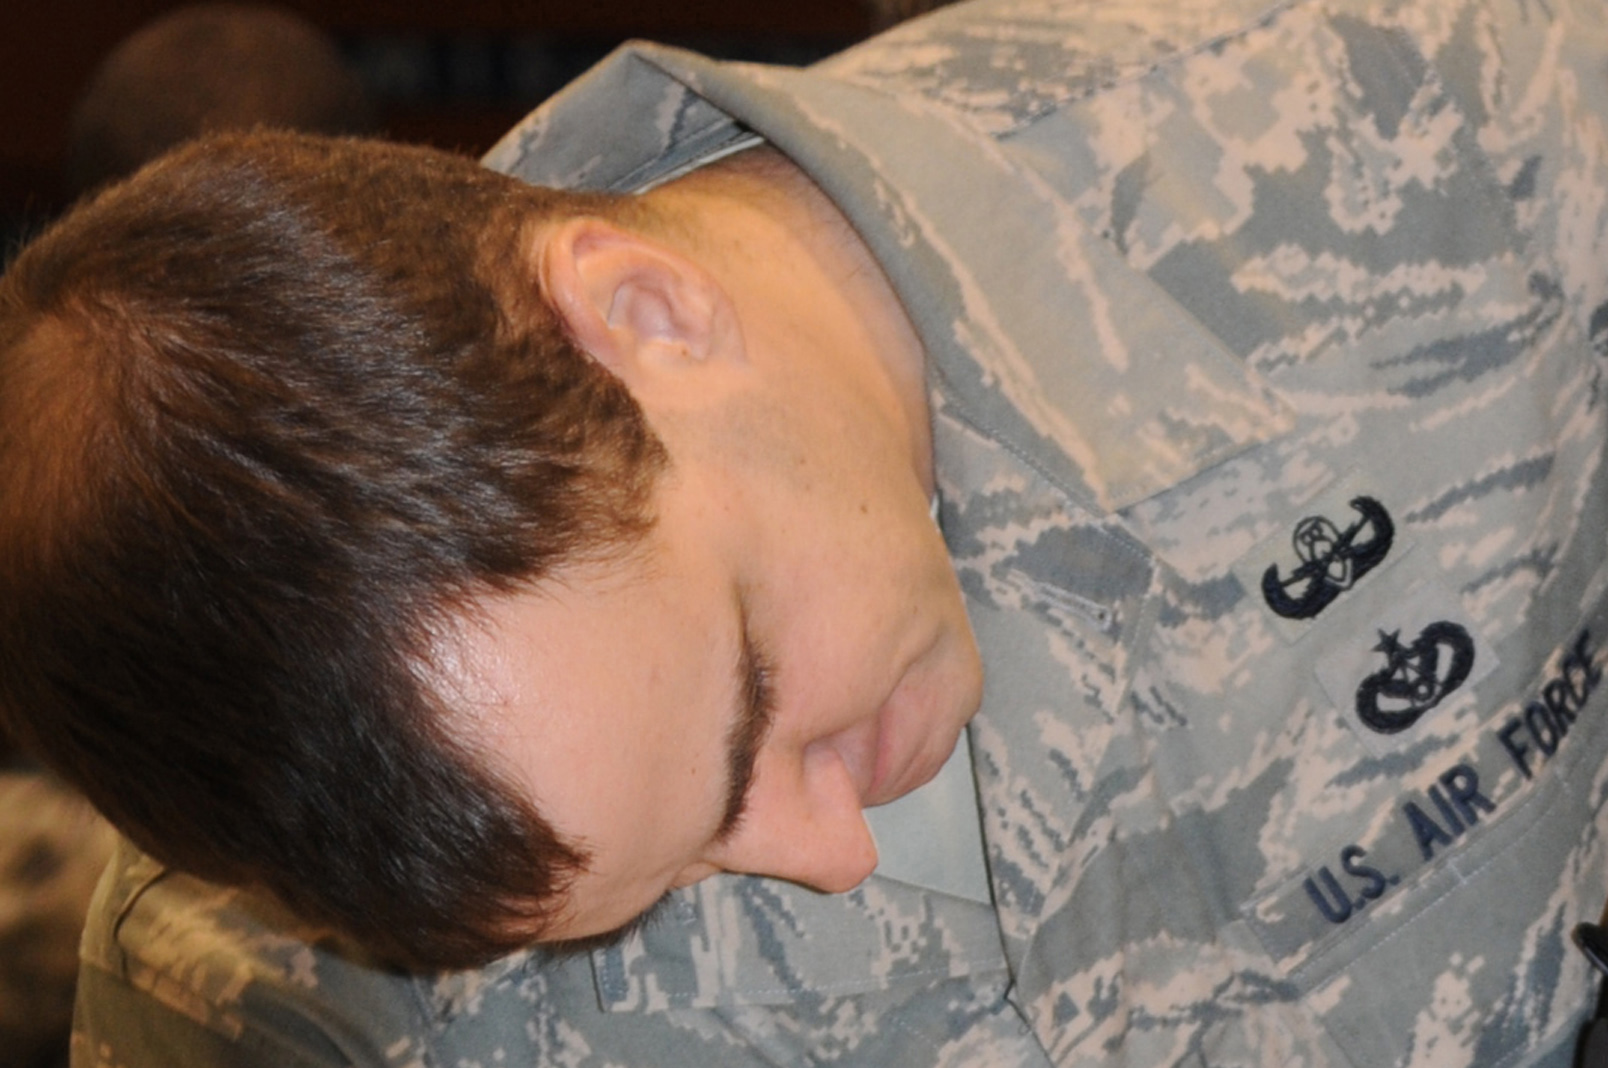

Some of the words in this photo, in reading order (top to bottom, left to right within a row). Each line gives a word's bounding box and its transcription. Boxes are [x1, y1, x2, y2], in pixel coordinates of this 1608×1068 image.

[1302, 843, 1400, 925] U.S.
[1402, 763, 1497, 861] AIR
[1497, 629, 1603, 781] FORCE
